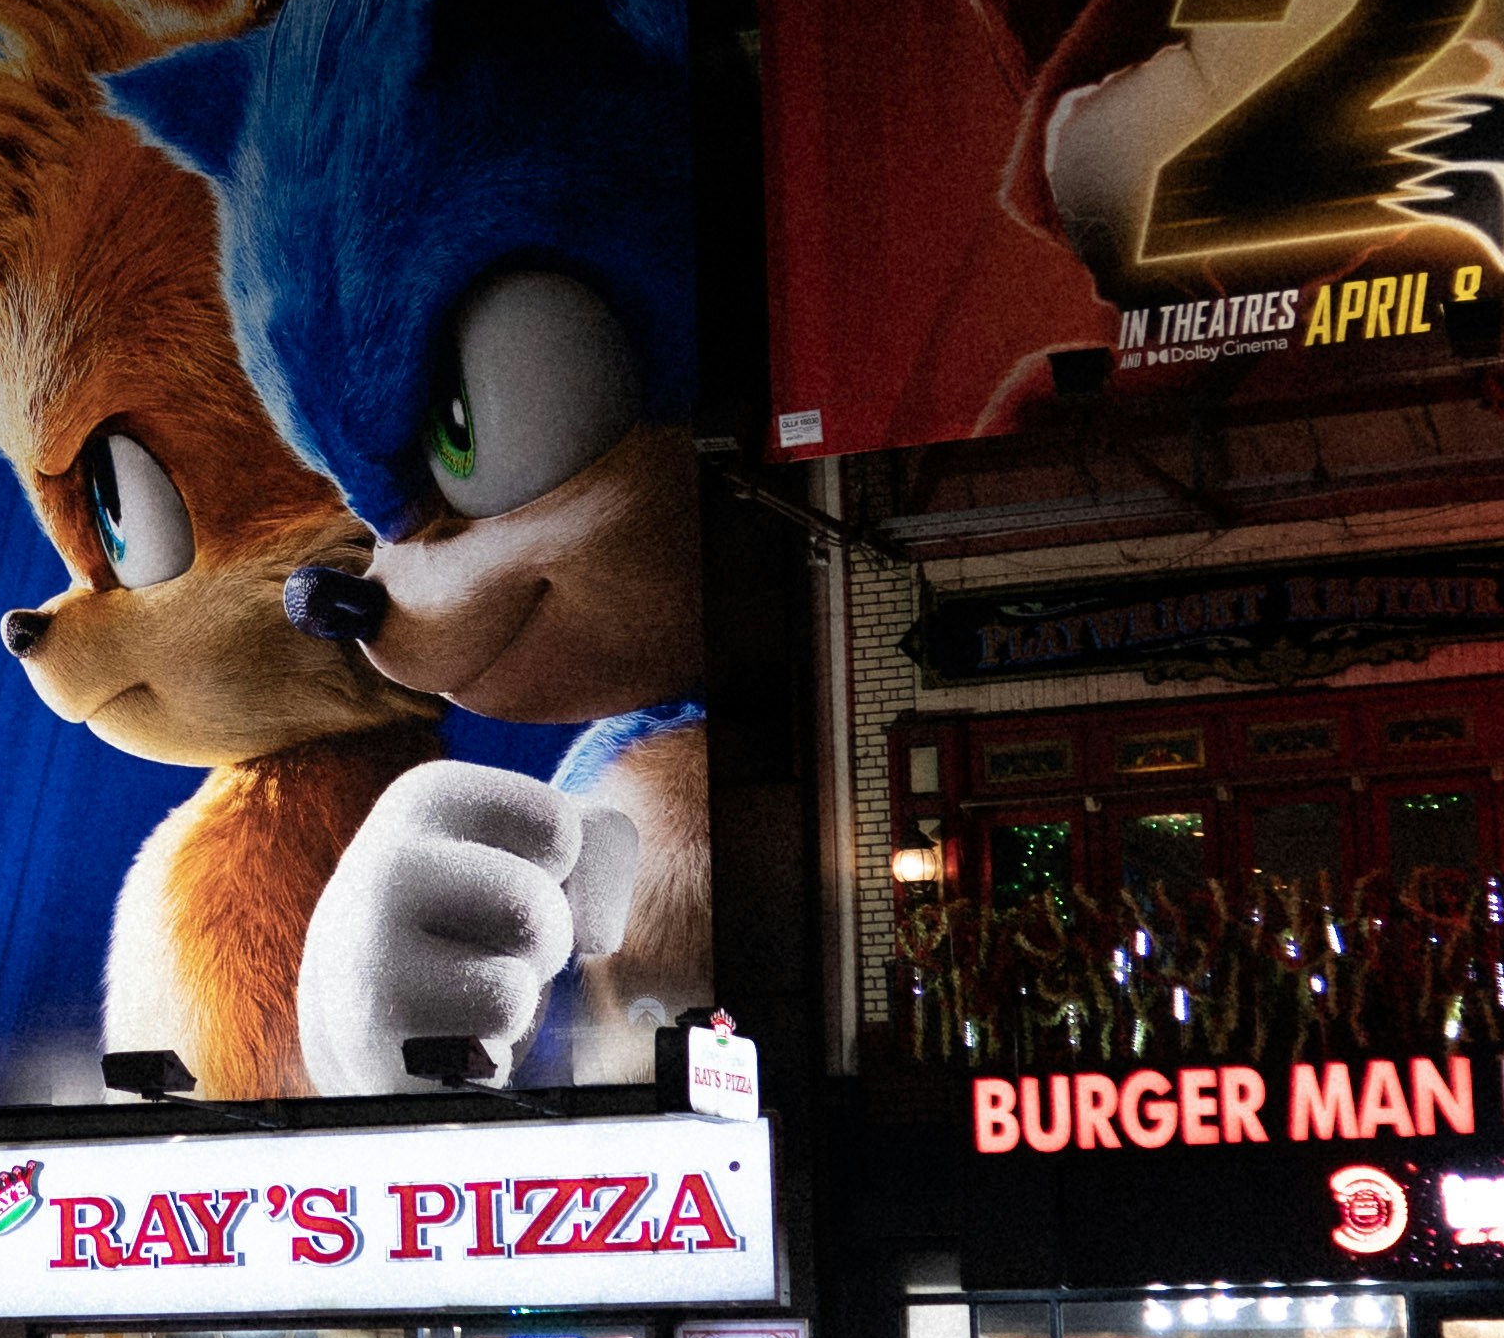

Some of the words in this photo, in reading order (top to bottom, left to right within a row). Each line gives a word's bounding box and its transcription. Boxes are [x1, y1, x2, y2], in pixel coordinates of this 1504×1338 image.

[1118, 308, 1149, 350] IN
[1158, 289, 1299, 345] THEATRES
[1305, 272, 1431, 347] APRIL
[1120, 352, 1142, 370] AND
[1171, 345, 1220, 363] Dolby
[1223, 336, 1289, 358] Cinema
[975, 584, 1267, 668] PLAYWRIGHT
[973, 1066, 1269, 1154] BURGER
[1288, 1057, 1475, 1142] MAN
[46, 1182, 362, 1269] RAY'S
[386, 1170, 747, 1259] PIZZA
